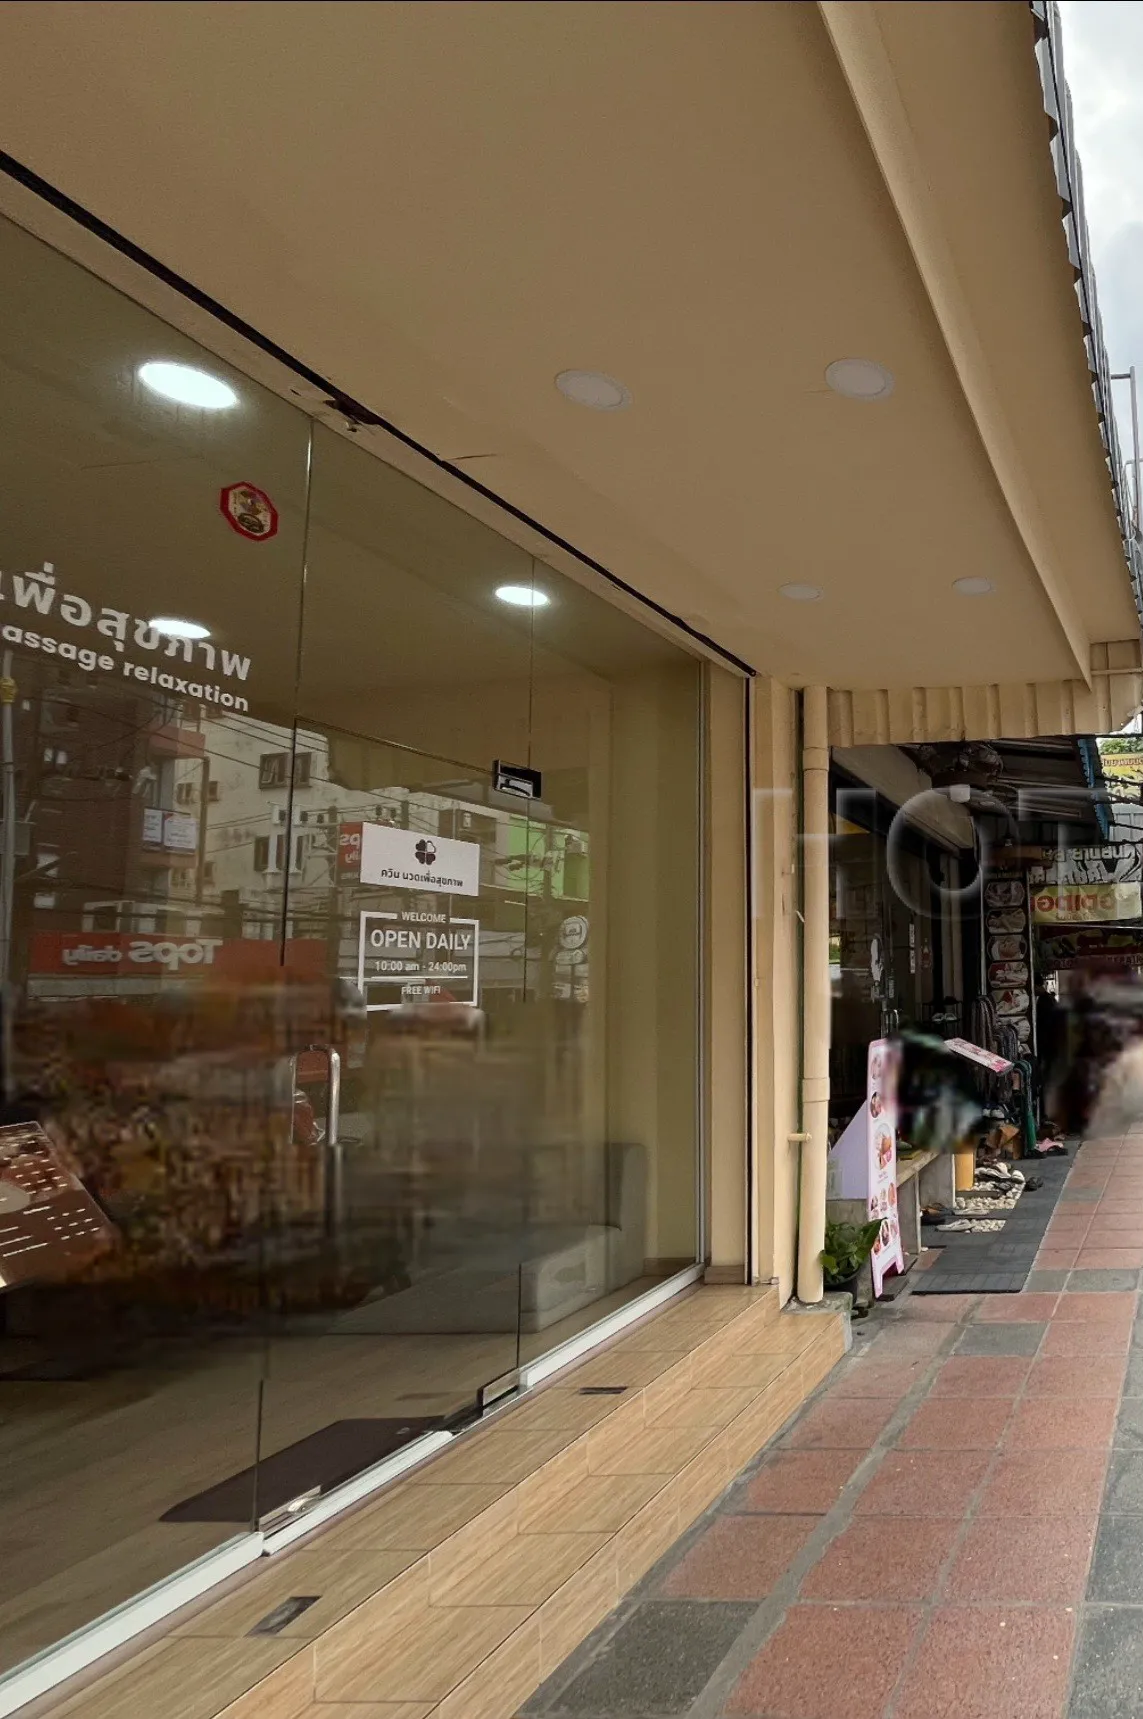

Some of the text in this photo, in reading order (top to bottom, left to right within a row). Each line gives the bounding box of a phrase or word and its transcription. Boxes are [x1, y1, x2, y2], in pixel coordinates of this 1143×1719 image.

[122, 660, 250, 712] relaxation
[401, 911, 446, 923] WELCOME
[370, 929, 471, 950] OPEN DAILY
[375, 960, 402, 971] 10:00
[405, 962, 420, 971] am
[428, 961, 467, 974] 24:00pm
[401, 985, 441, 995] FREE WIFI
